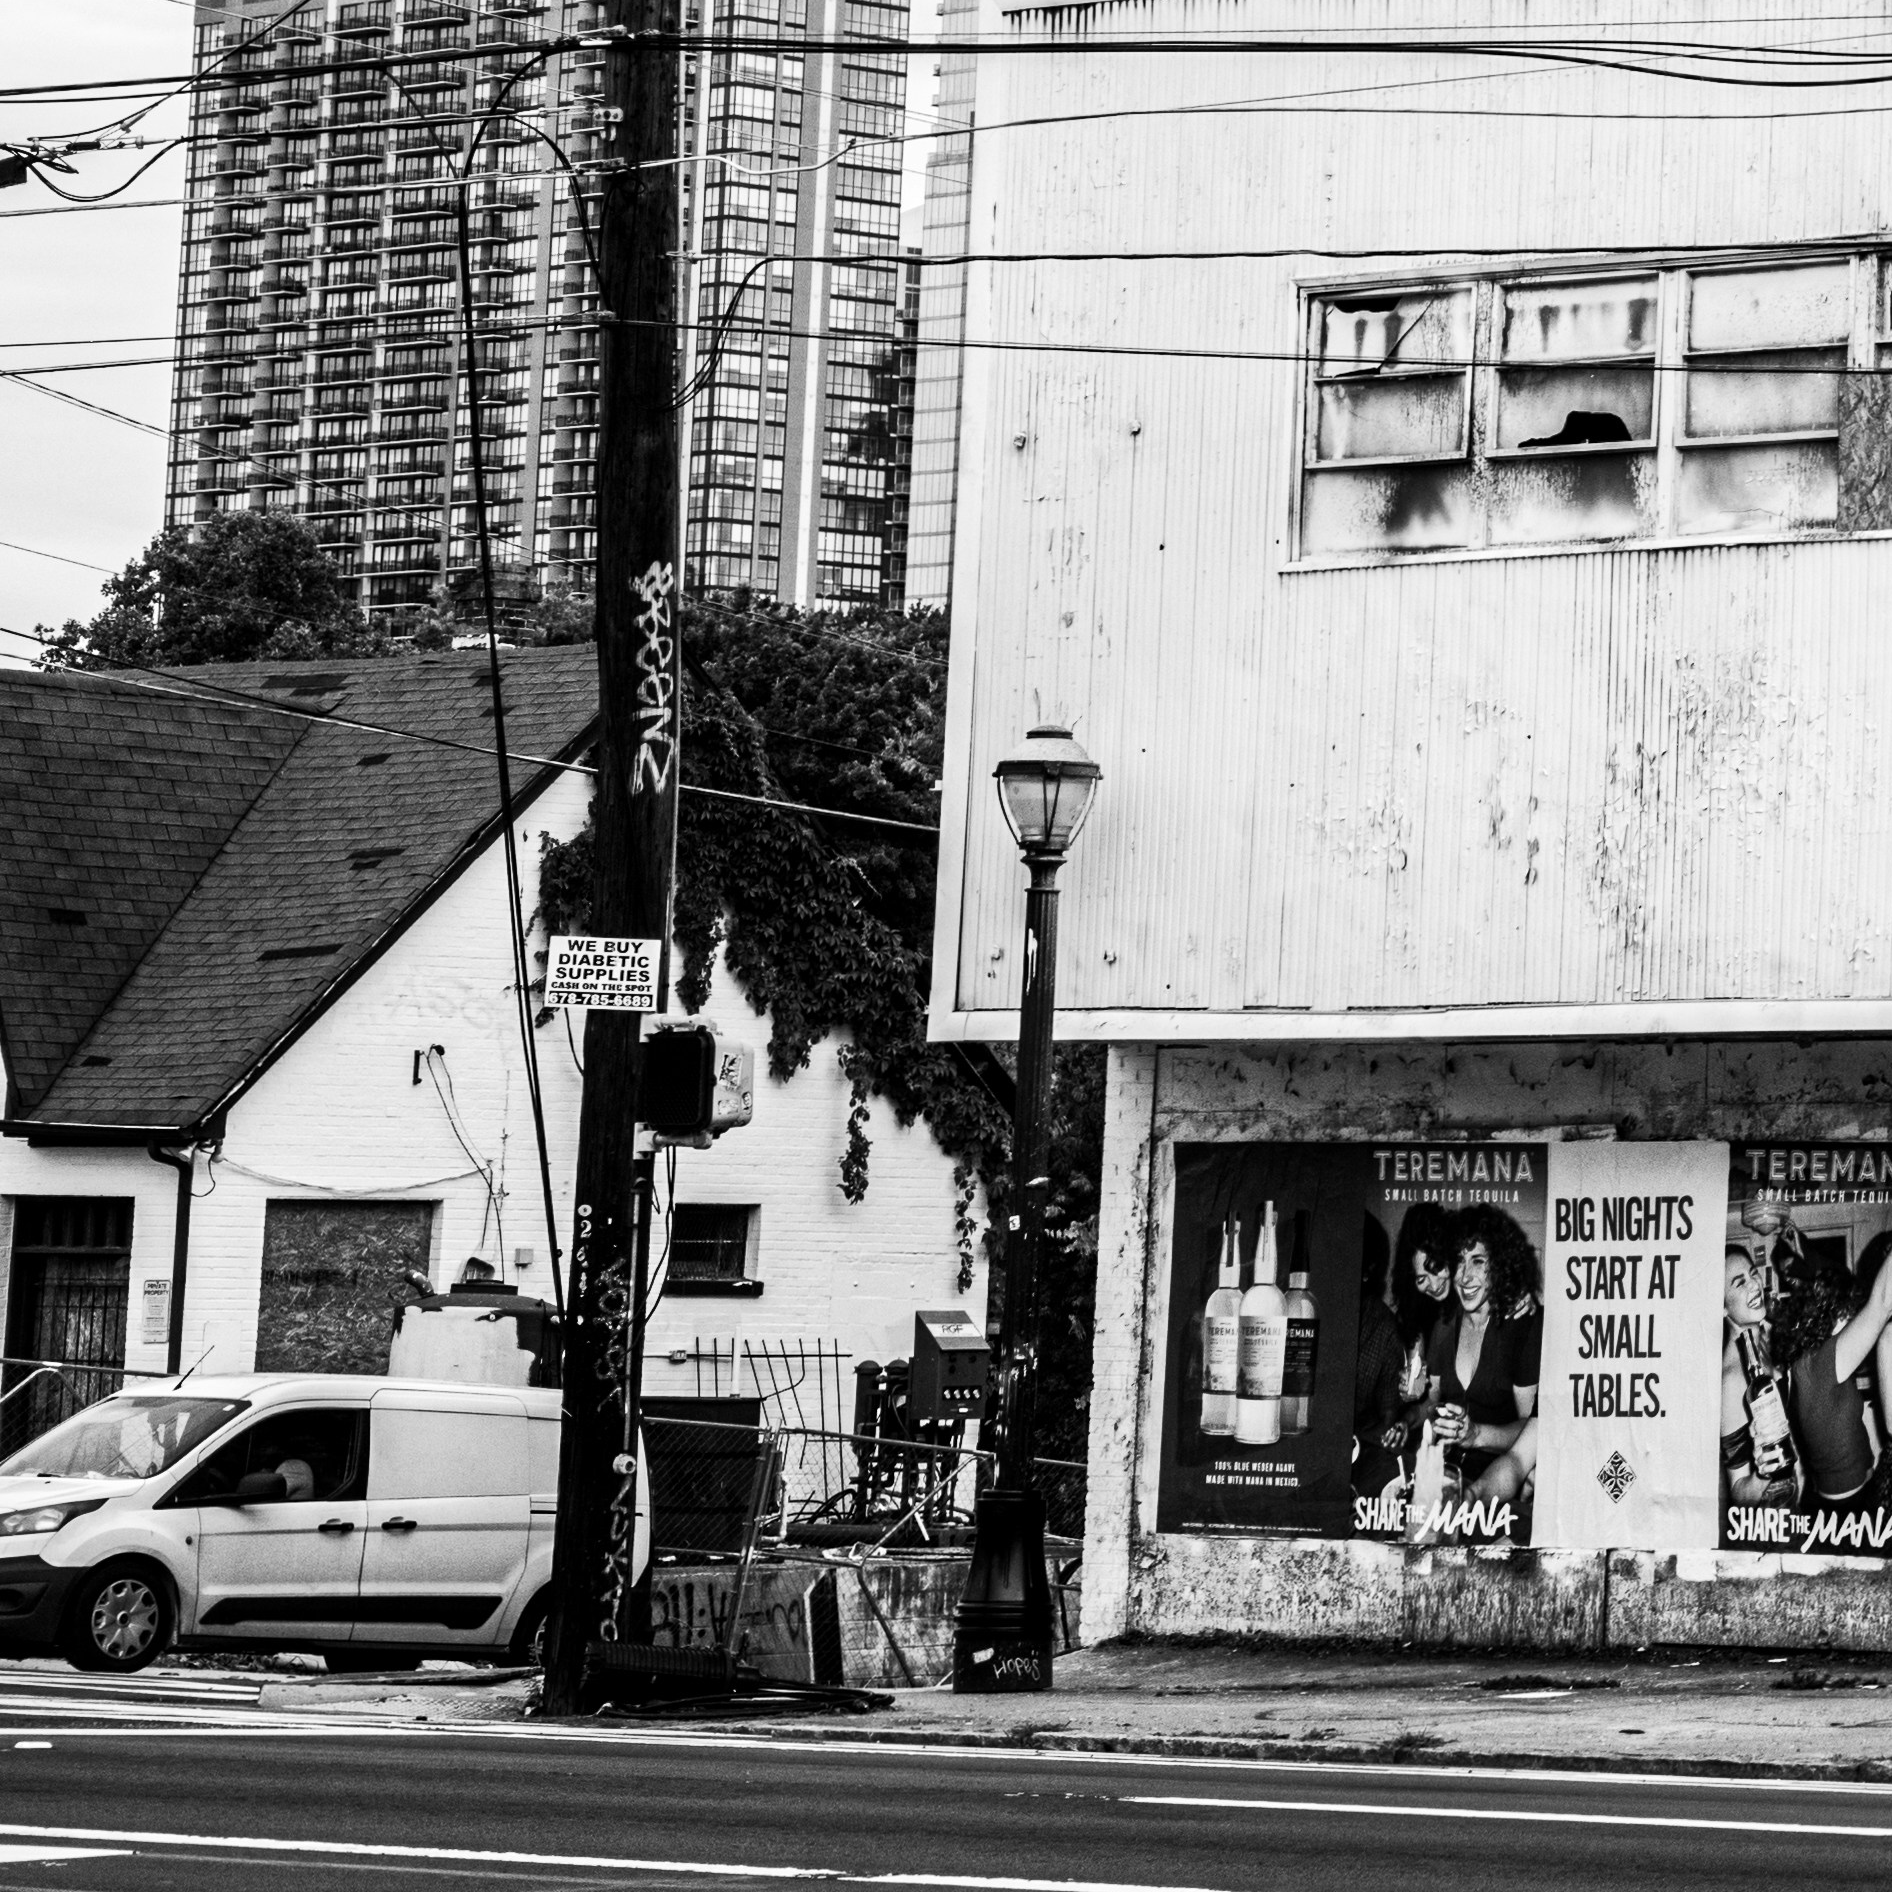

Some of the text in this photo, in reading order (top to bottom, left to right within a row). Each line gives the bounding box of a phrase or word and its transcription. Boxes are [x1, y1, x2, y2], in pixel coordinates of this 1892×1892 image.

[567, 940, 643, 953] WE BUY
[559, 954, 649, 968] DIABETIC
[556, 967, 650, 982] SUPPLIES
[599, 983, 622, 991] THE
[625, 984, 652, 992] SPOT
[549, 992, 651, 1007] 678-785-6689
[1373, 1150, 1533, 1183] TEREMANA
[1384, 1189, 1519, 1203] SMALL BATCH TEQUILA
[1757, 1189, 1797, 1202] SMALL
[1805, 1190, 1845, 1203] BATCH
[1555, 1195, 1694, 1242] BIG NIGHTS
[1565, 1254, 1681, 1301] START AT
[1578, 1314, 1662, 1359] SMALL
[1569, 1372, 1666, 1418] TABLES.
[1214, 1461, 1295, 1473] 100% BLUE WEBER AGAVE
[1206, 1475, 1225, 1484] MADE
[1227, 1475, 1243, 1485] WITH
[1265, 1476, 1273, 1486] IN
[1354, 1495, 1518, 1543] SHARE THE MANA
[1726, 1506, 1791, 1543] SHARE
[1789, 1514, 1811, 1534] THE
